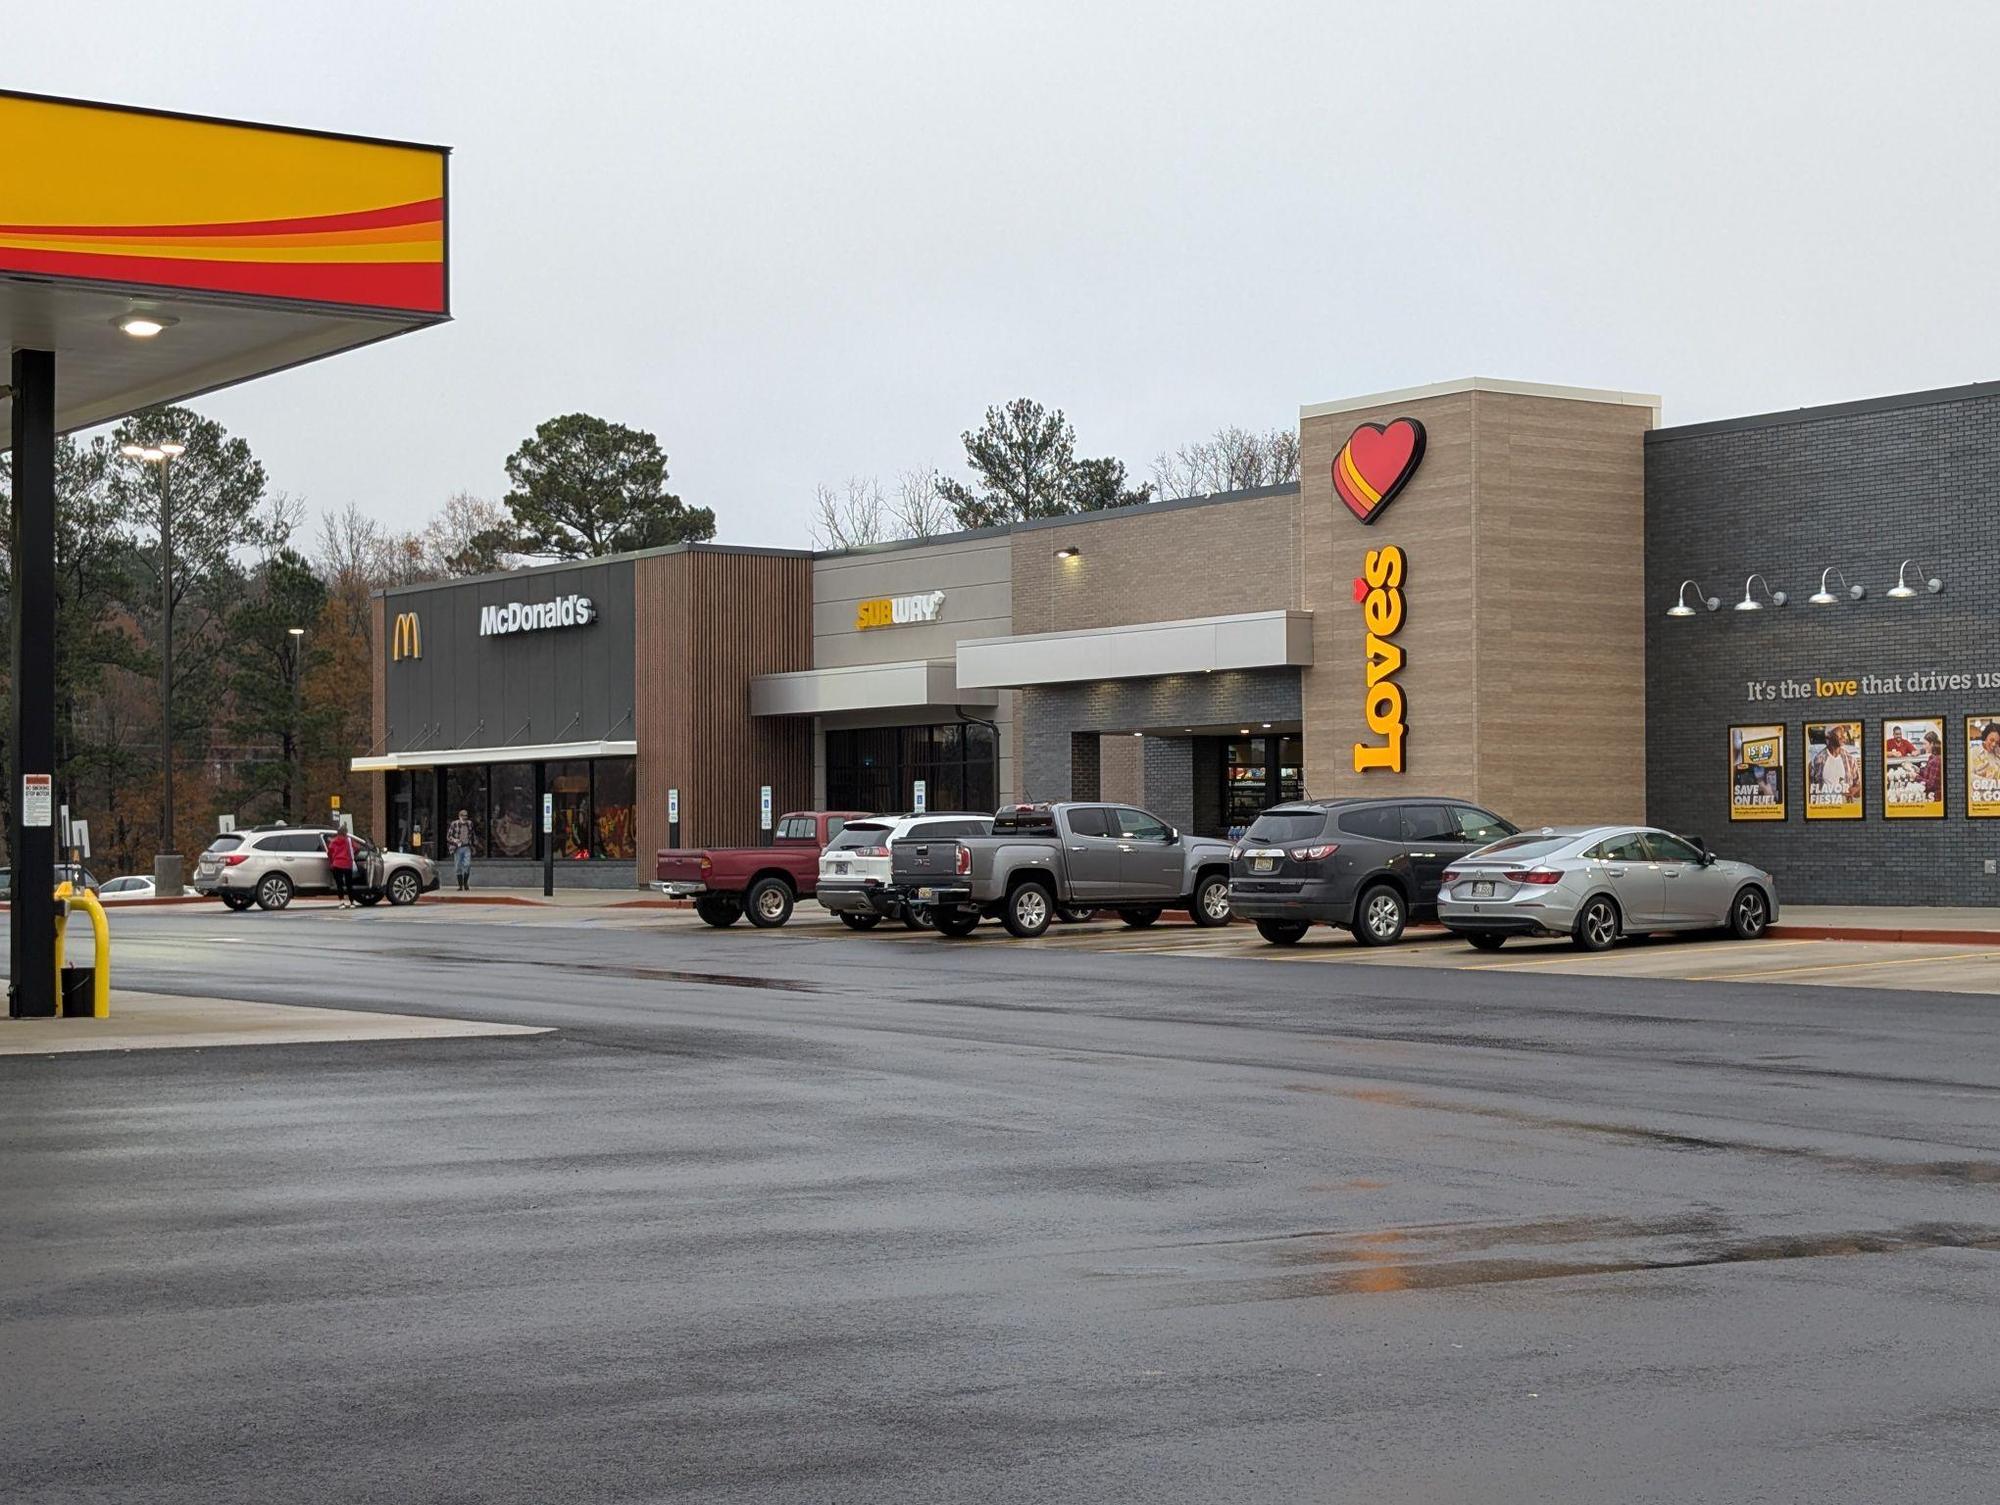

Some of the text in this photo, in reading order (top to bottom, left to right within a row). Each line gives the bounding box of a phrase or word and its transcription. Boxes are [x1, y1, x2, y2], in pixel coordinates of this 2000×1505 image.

[480, 595, 592, 635] McDonald's
[857, 591, 945, 630] SUBWAY
[1747, 671, 2000, 700] It's the love that drives us
[1734, 784, 1759, 795] SAVE
[1810, 783, 1850, 794] FLAVOR
[1972, 780, 2000, 790] GRA
[1734, 795, 1776, 805] ON FUEL
[1810, 794, 1844, 805] FIESTA
